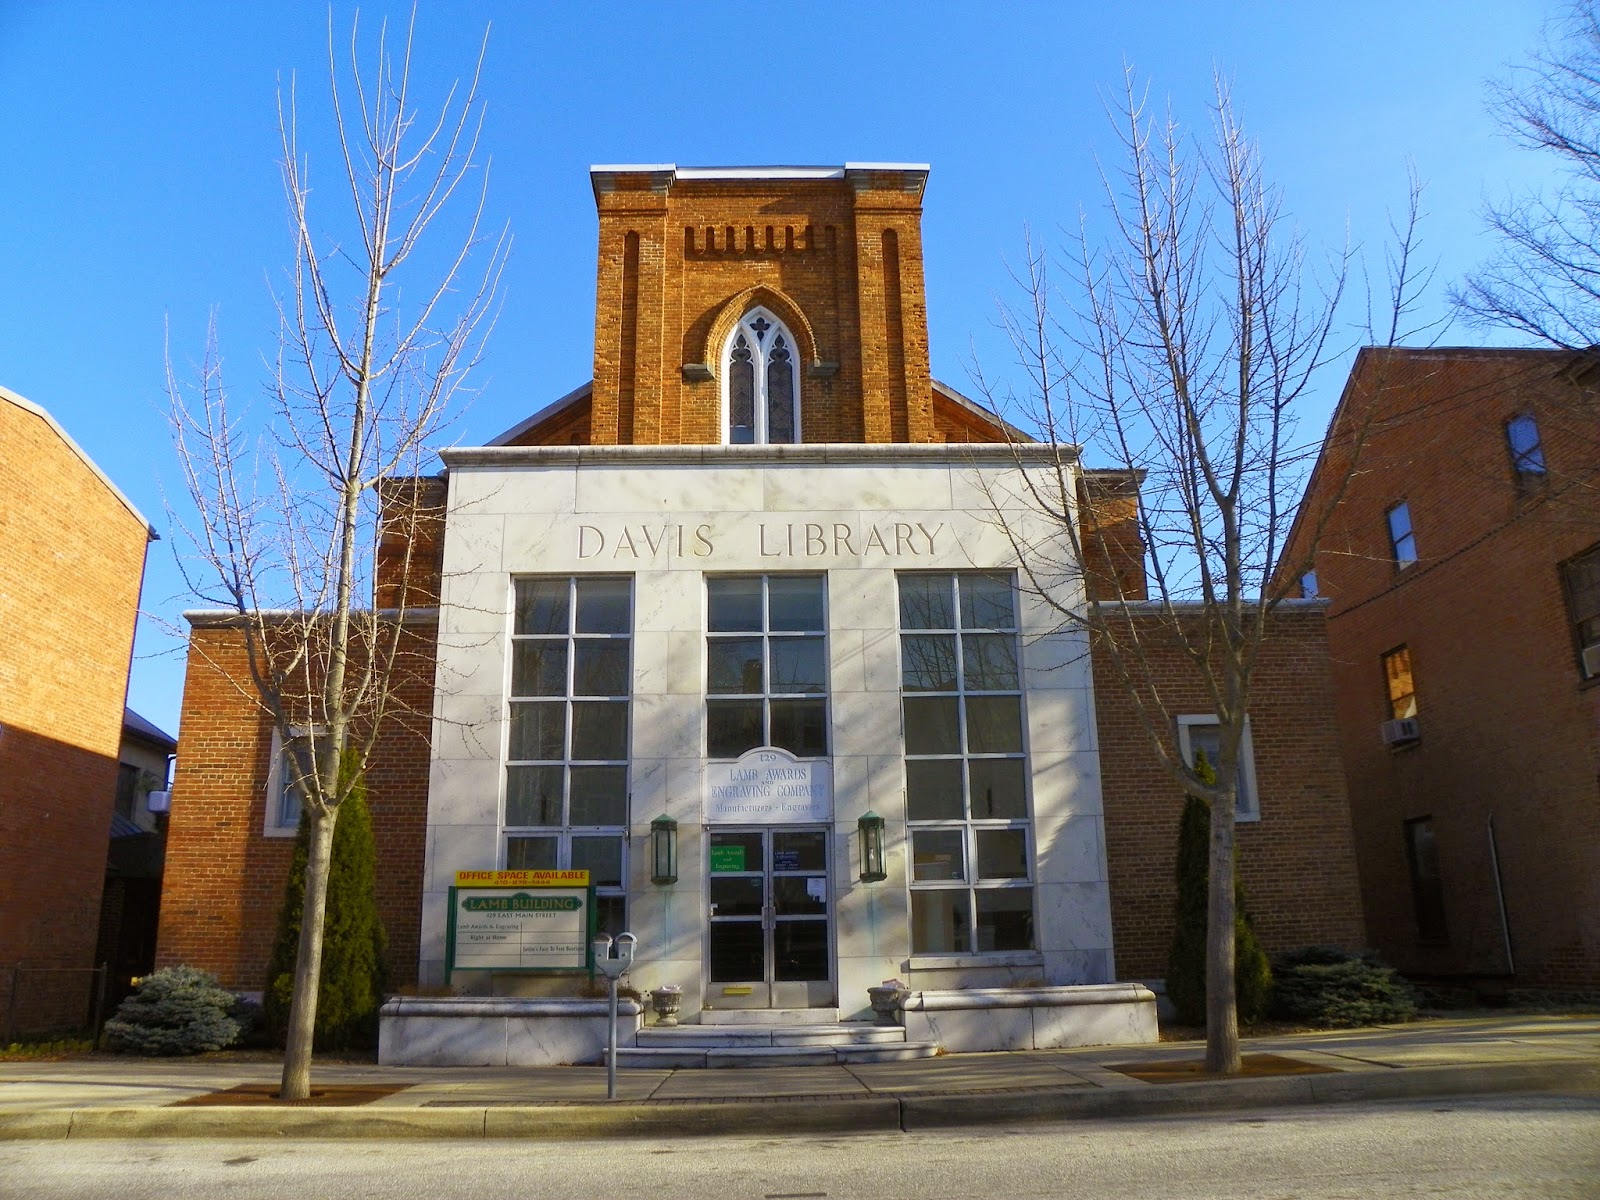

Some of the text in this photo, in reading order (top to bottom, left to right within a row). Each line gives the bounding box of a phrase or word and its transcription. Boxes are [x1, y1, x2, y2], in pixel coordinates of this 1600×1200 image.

[577, 522, 944, 560] DAVIS LIBRARY
[760, 754, 777, 762] 129
[730, 768, 807, 781] LAMB AWARDS
[711, 784, 825, 798] ENGRAVING COMPANY
[715, 803, 772, 813] Manufacturers
[780, 803, 820, 813] Engravers
[459, 871, 586, 880] OFFICE SPACE AVAILABLE
[470, 898, 574, 909] LAMB BUILDING
